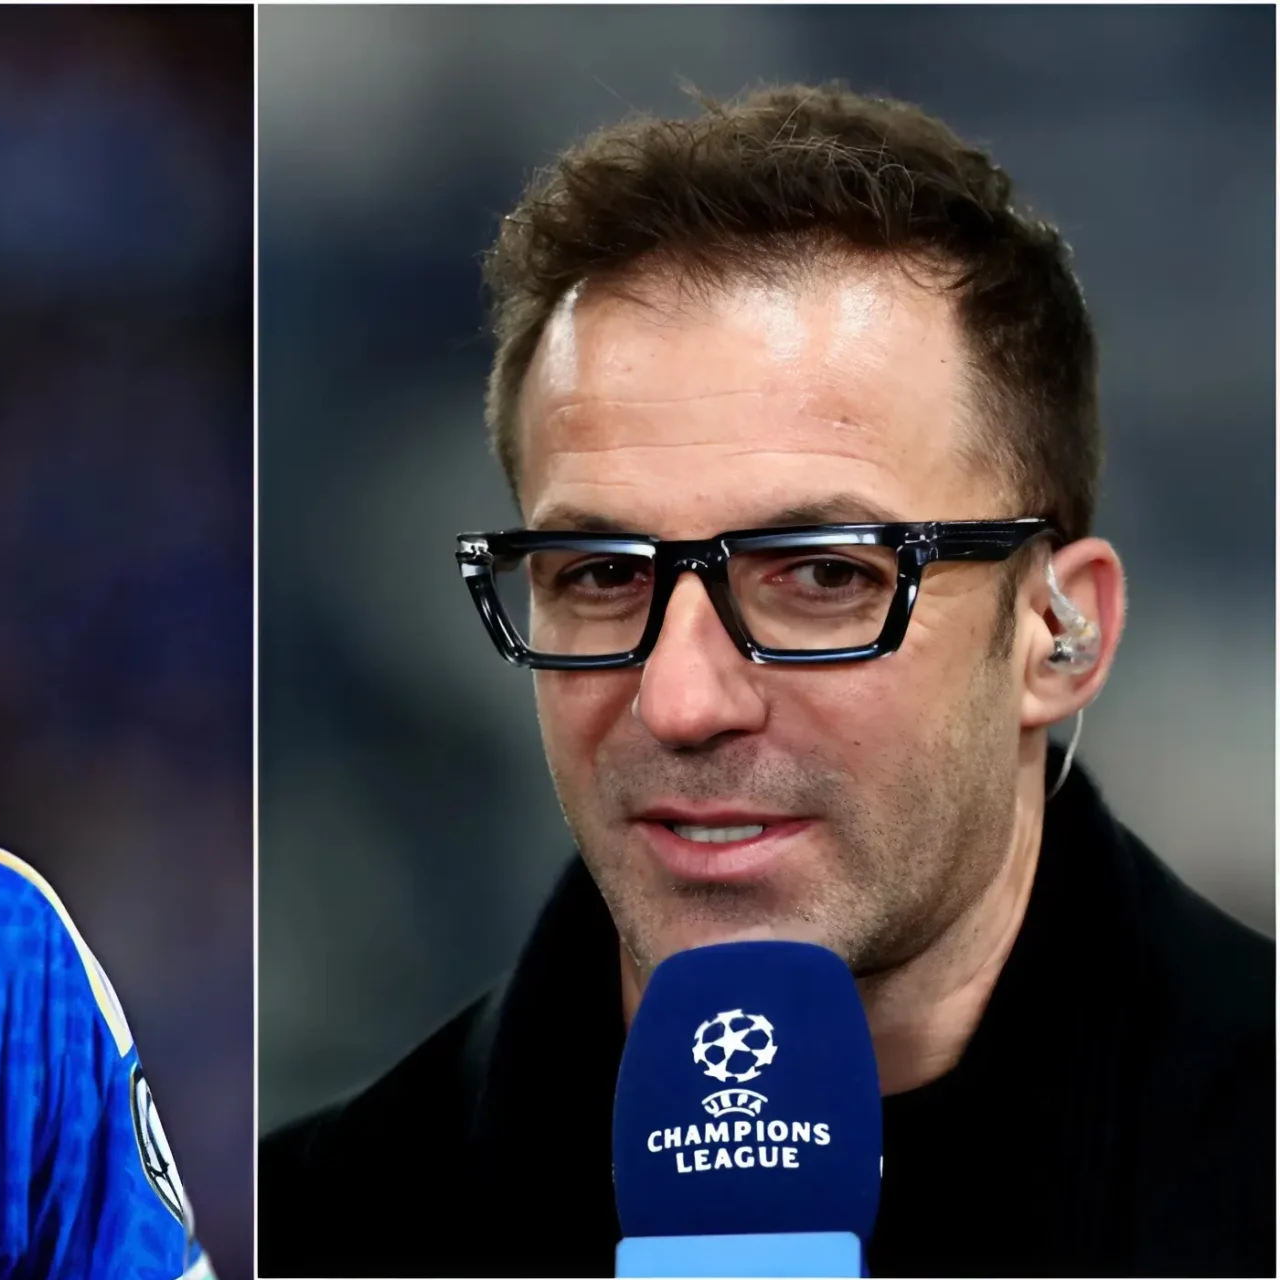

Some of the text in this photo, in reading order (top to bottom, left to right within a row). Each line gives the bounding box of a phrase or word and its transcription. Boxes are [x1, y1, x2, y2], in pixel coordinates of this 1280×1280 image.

[704, 1093, 762, 1115] UEFA
[647, 1120, 831, 1153] CHAMPIONS
[676, 1146, 800, 1173] LEAGUE
